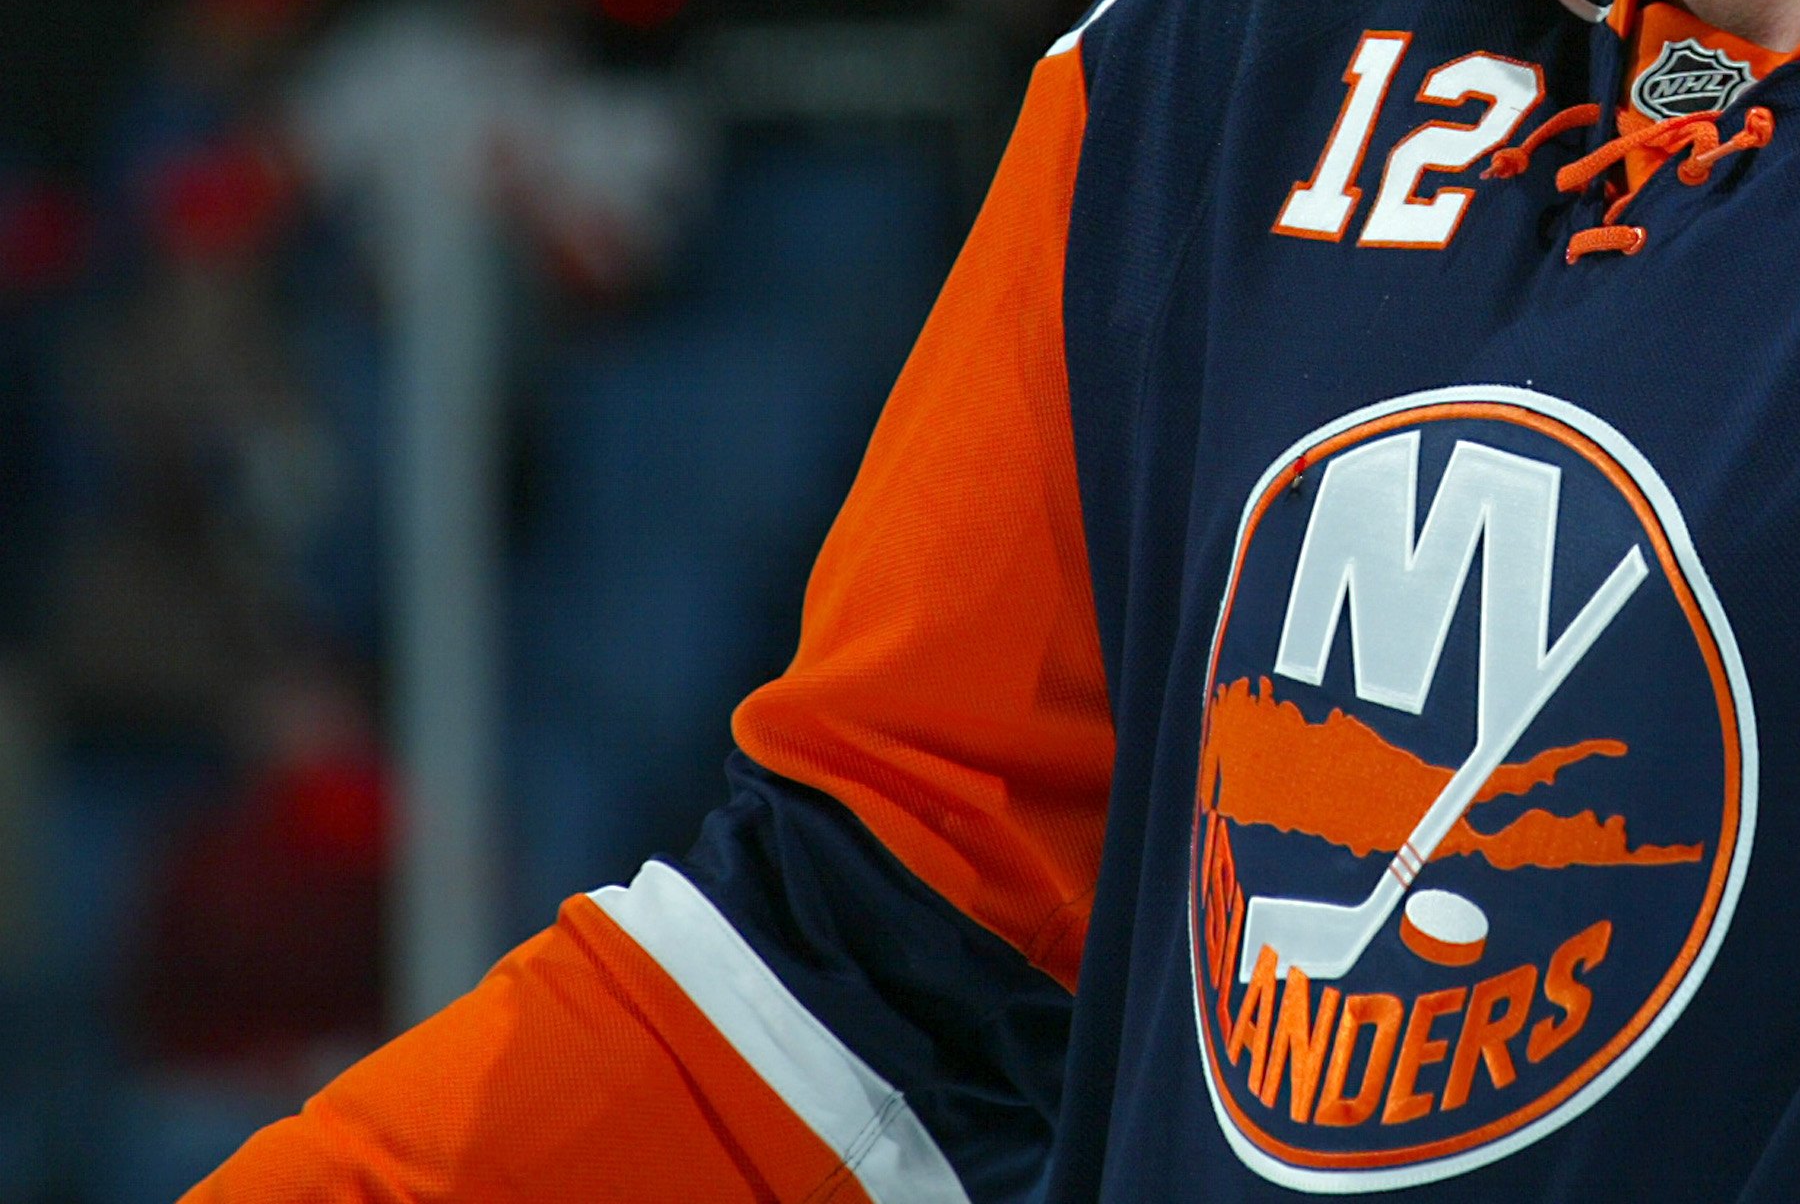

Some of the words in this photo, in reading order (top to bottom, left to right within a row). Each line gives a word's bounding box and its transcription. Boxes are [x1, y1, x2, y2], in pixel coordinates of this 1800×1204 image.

[1271, 29, 1546, 249] 12
[1650, 74, 1724, 99] NHL
[1274, 429, 1650, 796] NY
